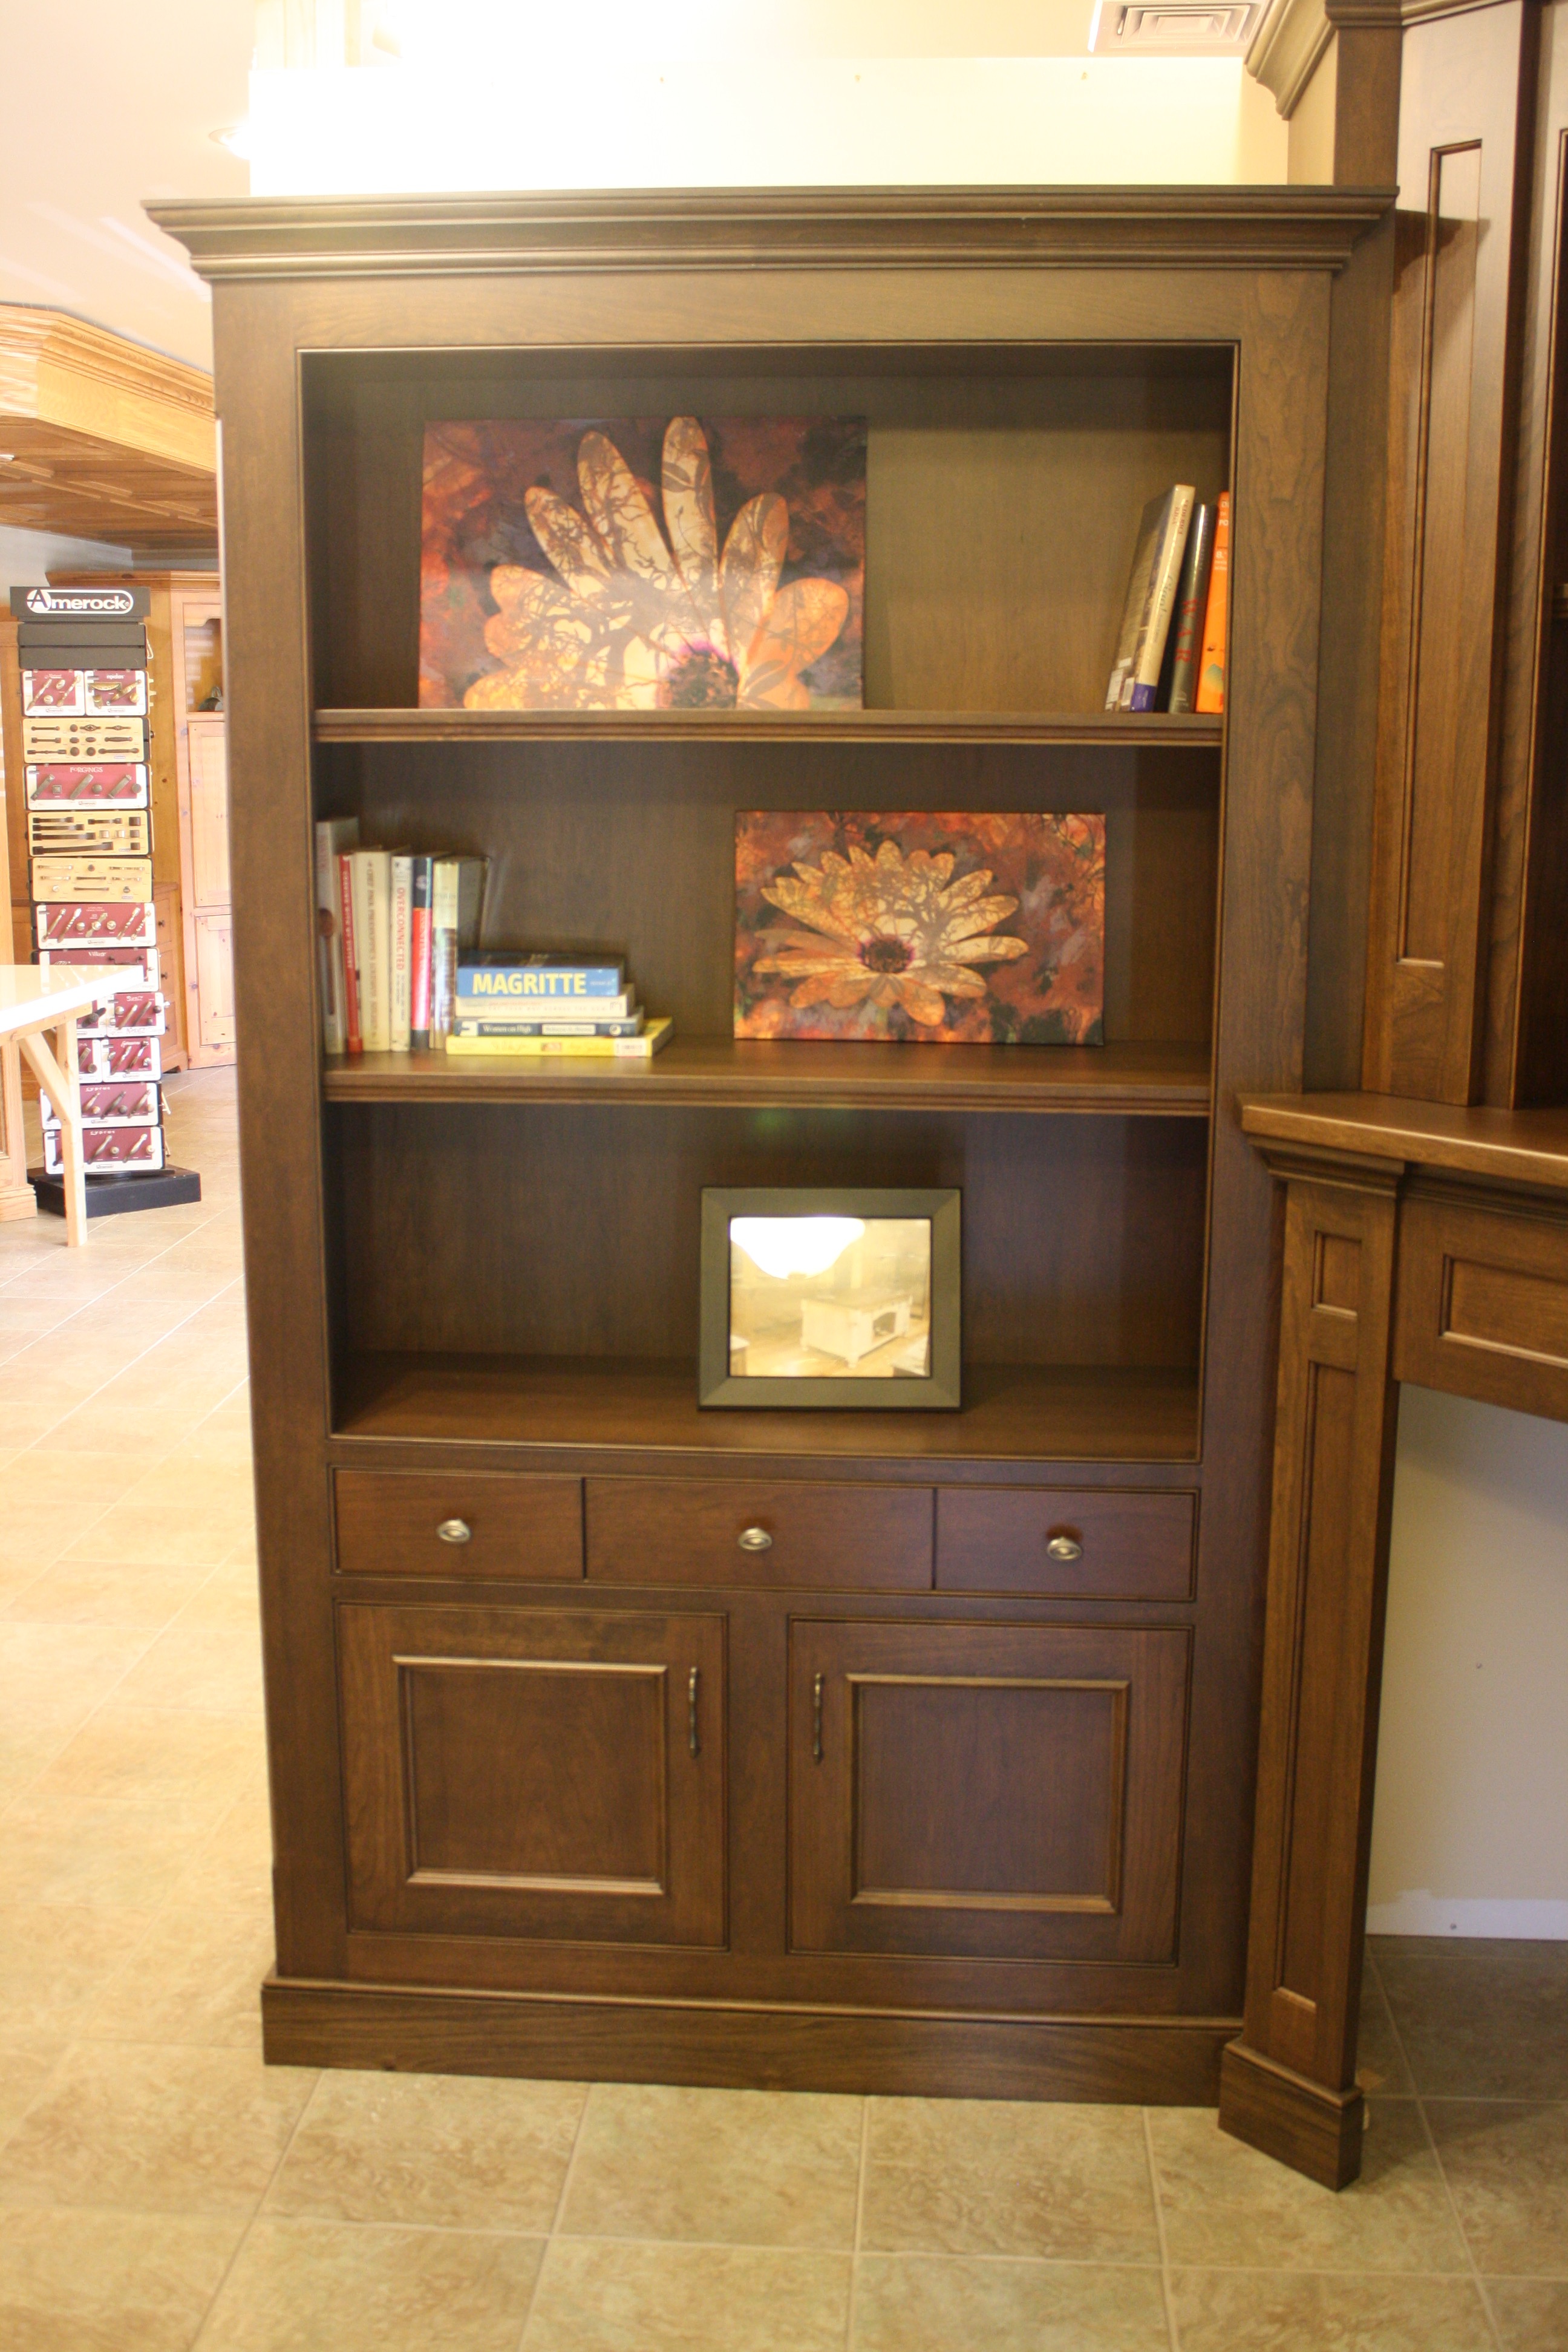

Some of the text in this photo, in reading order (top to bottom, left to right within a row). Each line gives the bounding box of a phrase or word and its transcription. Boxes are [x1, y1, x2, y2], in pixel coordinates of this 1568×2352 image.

[27, 589, 127, 610] Amerock
[396, 887, 406, 970] OVERCONNECTED
[472, 972, 587, 995] MAGRITTE
